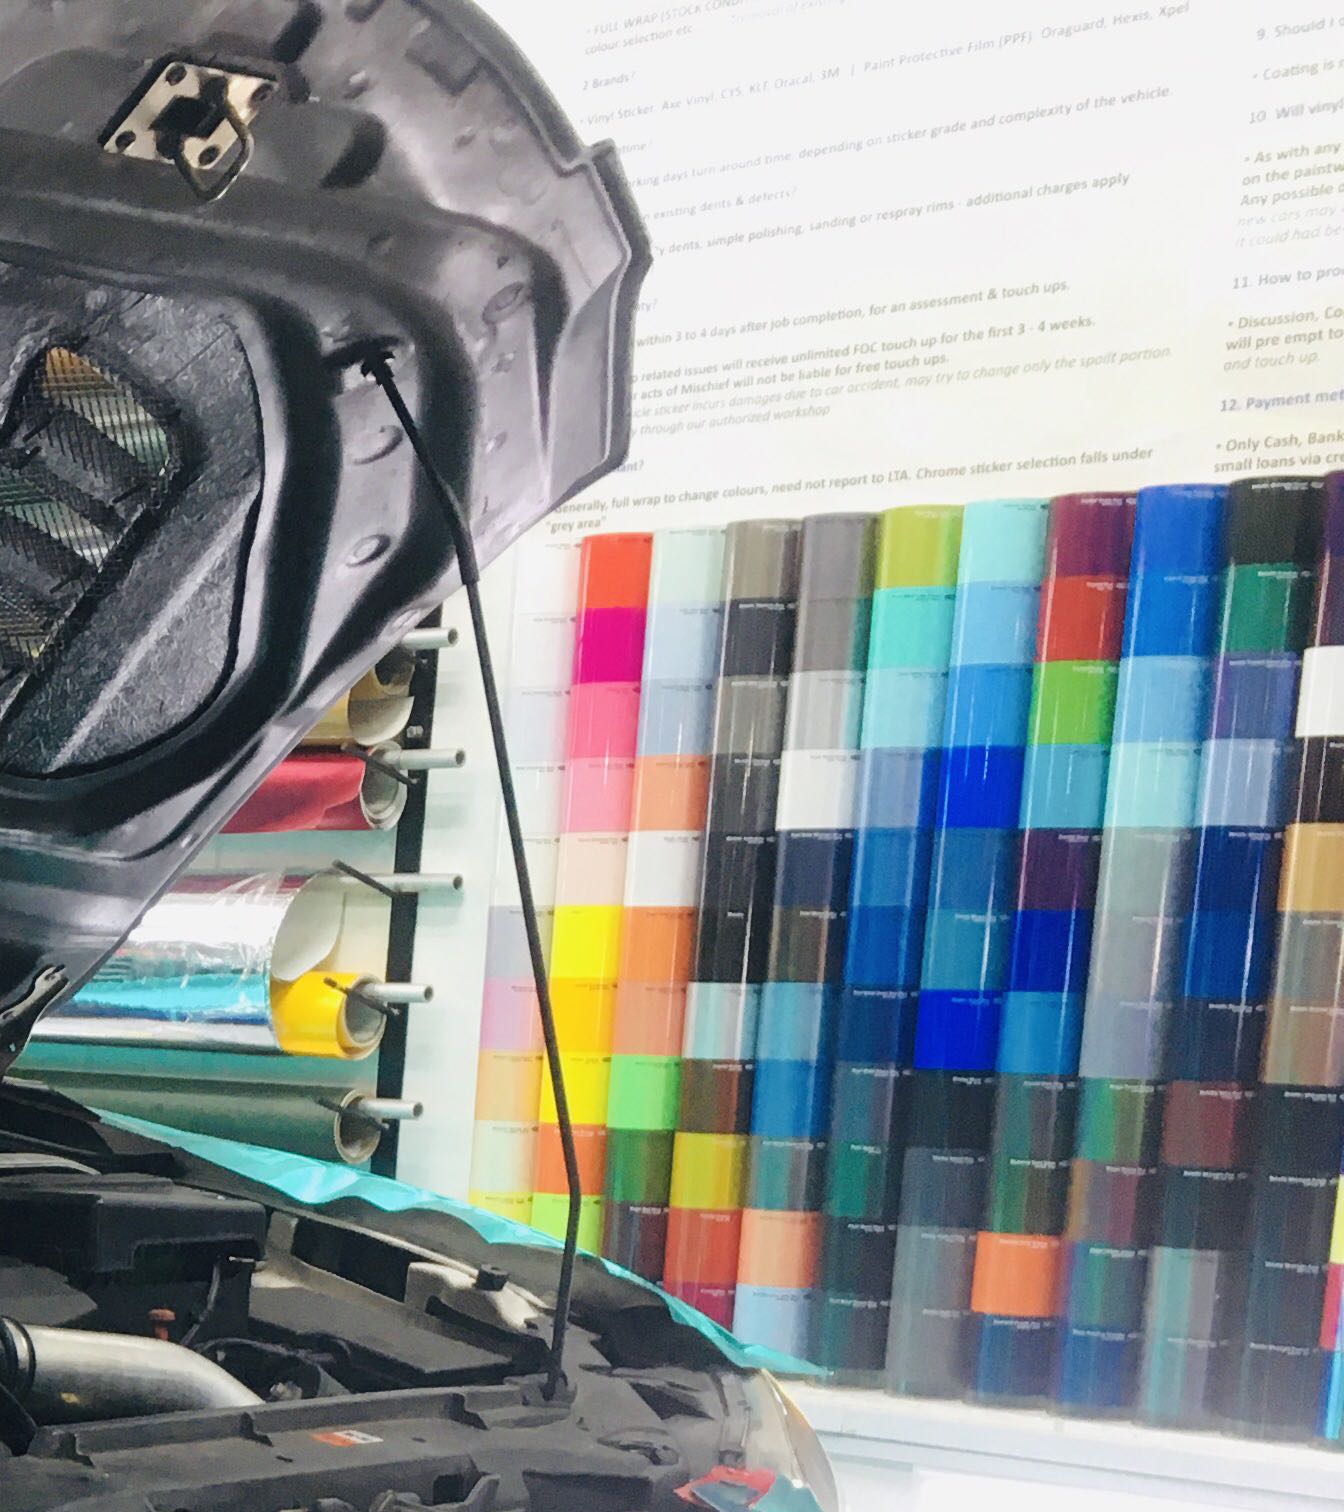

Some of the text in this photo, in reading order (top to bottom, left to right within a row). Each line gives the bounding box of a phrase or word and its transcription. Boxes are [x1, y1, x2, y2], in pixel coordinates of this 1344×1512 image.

[1274, 17, 1324, 36] Should
[1262, 58, 1335, 80] Coating is
[662, 170, 688, 183] days
[692, 165, 716, 177] turn
[720, 155, 761, 172] around
[798, 140, 862, 159] depending
[866, 137, 882, 146] on
[886, 128, 926, 143] sticker
[930, 121, 966, 139] grade
[970, 115, 994, 129] and
[998, 104, 1072, 124] complexity
[1075, 98, 1090, 111] of
[1094, 96, 1116, 108] the
[1254, 144, 1340, 162] As with any
[1242, 168, 1290, 185] on the
[1240, 183, 1334, 207] Any possible
[706, 232, 744, 247] simple
[809, 215, 856, 231] sanding
[860, 213, 874, 223] or
[876, 206, 922, 221] respray
[926, 201, 954, 213] rims
[966, 186, 1032, 206] additional
[1036, 181, 1088, 196] charges
[1092, 173, 1129, 189] apply
[1258, 270, 1312, 285] How to
[636, 332, 672, 346] within
[684, 330, 696, 340] to
[710, 325, 736, 338] days
[740, 320, 768, 333] after
[770, 315, 790, 332] job
[792, 307, 864, 326] completion,
[868, 304, 887, 316] for
[890, 303, 906, 313] an
[910, 291, 982, 310] assessment
[1002, 282, 1039, 298] touch
[1043, 282, 1070, 295] ups.
[1238, 310, 1318, 329] Discussion,
[640, 365, 682, 381] related
[684, 364, 718, 376] issues
[722, 357, 742, 371] will
[746, 353, 788, 368] receive
[790, 344, 850, 362] unlimited
[852, 341, 878, 355] FOC
[880, 336, 918, 351] touch
[920, 336, 936, 349] up
[940, 332, 958, 344] for
[962, 329, 984, 341] the
[987, 325, 1013, 338] first
[1049, 315, 1095, 330] weeks.
[1226, 336, 1251, 350] will
[1255, 336, 1280, 351] pre
[1284, 329, 1324, 345] empt
[1222, 356, 1252, 371] and
[1254, 351, 1295, 368] touch
[640, 355, 949, 399] acts of Mischief will not be liable for free touch ups.
[1246, 392, 1310, 411] Payment
[640, 405, 830, 436] through our authorized workshop
[1224, 437, 1260, 453] Only
[1264, 433, 1302, 448] Cash,
[1214, 451, 1322, 472] small loans via
[610, 447, 1153, 508] full wrap to change colours, need not report to LTA. Chrome sticker selection falls under
